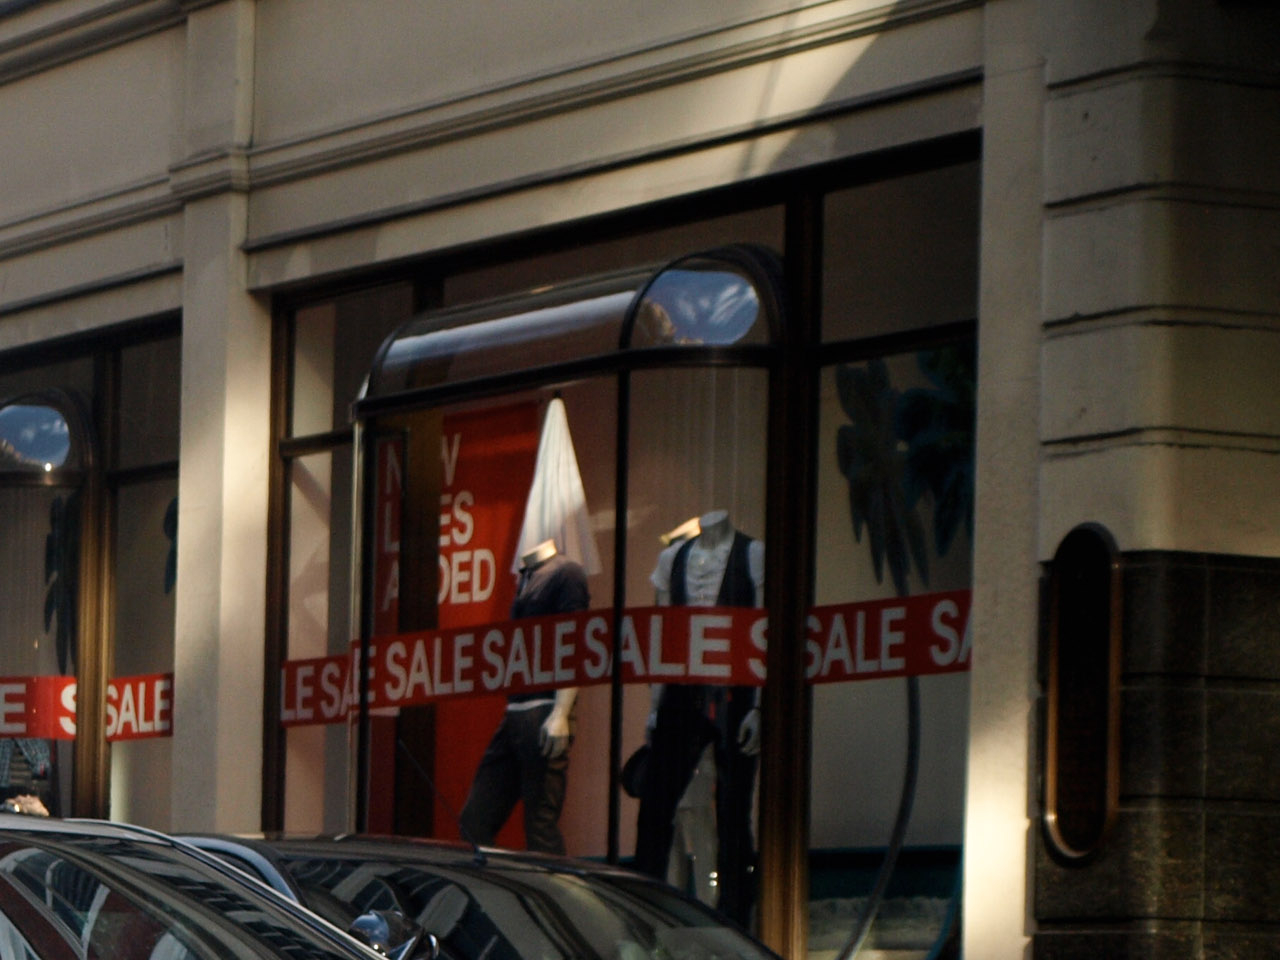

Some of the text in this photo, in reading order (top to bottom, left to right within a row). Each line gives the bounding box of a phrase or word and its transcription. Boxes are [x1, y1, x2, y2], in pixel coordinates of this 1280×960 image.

[384, 491, 474, 553] LES
[385, 634, 474, 700] SALE
[481, 621, 576, 690] SALE
[584, 614, 733, 679] SALE
[806, 607, 906, 676] SALE
[106, 680, 171, 737] SALE
